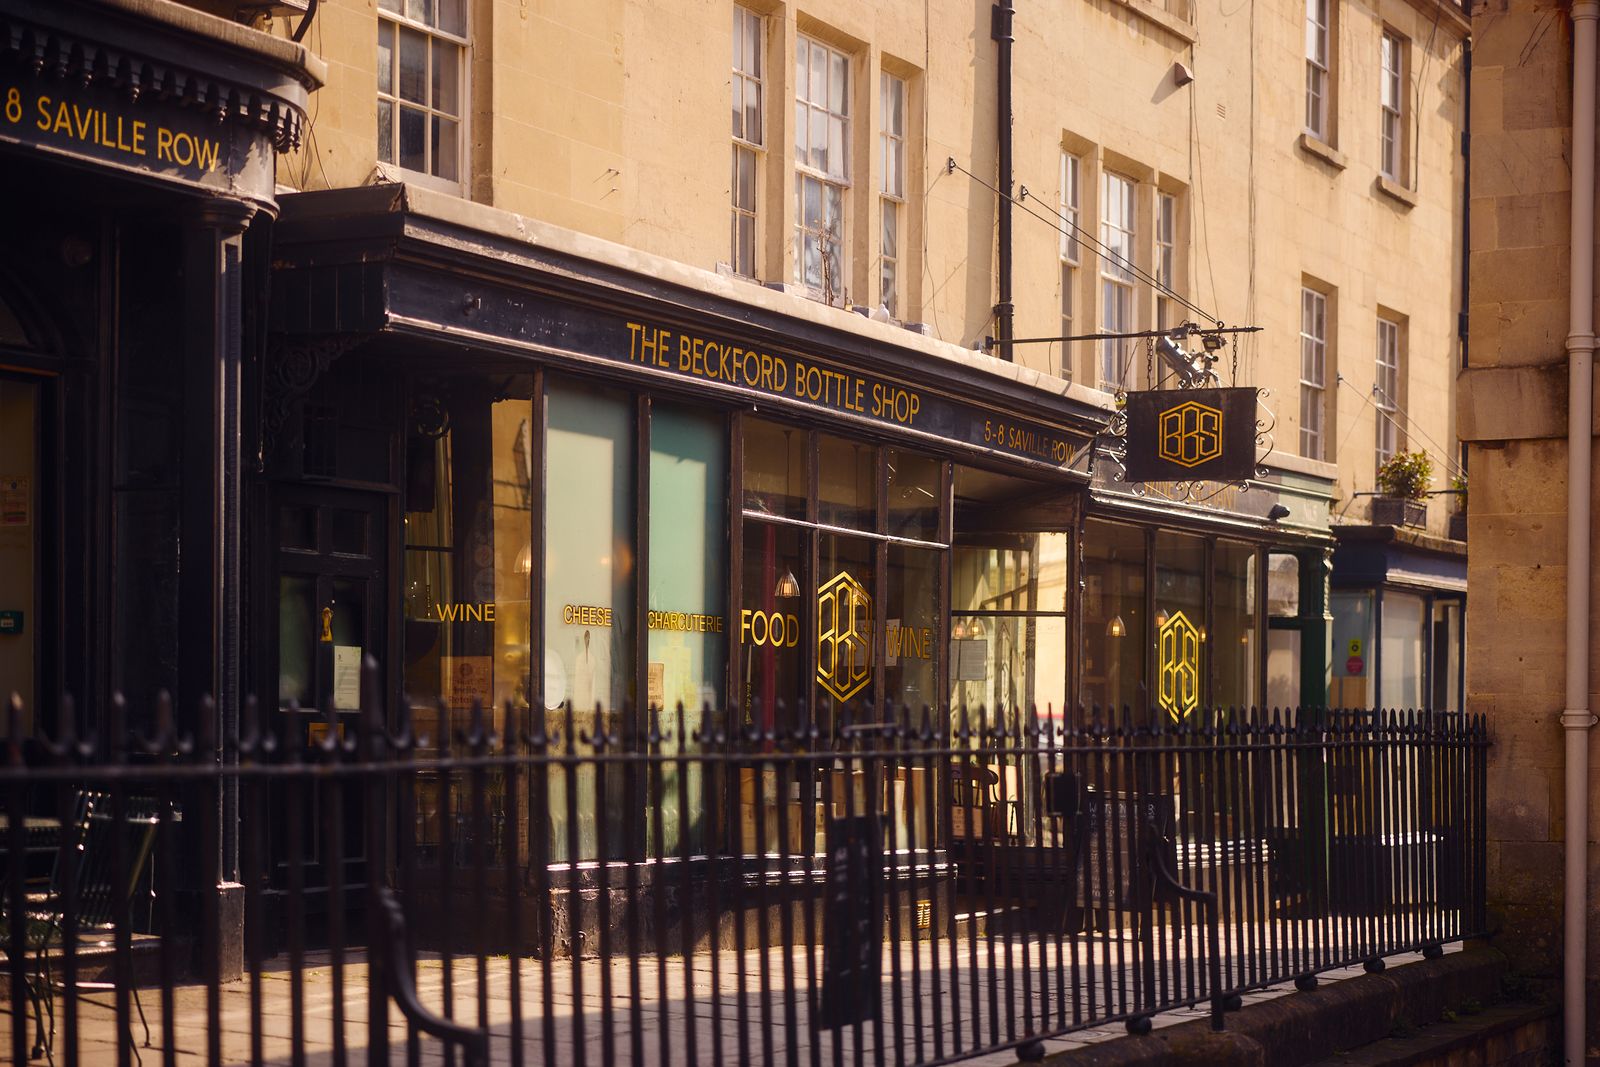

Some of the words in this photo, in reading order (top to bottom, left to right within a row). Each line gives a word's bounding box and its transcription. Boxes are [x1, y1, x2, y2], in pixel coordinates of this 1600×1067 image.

[5, 87, 22, 123] 8
[37, 96, 146, 155] SAVILLE
[157, 127, 220, 172] ROW
[626, 322, 671, 368] THE
[678, 335, 788, 393] BECKFORD
[795, 362, 865, 412] BOTTLE
[872, 383, 920, 424] SHOP
[984, 421, 1005, 445] 5-8
[1008, 426, 1048, 457] SAVILLE
[1051, 440, 1077, 464] ROW
[436, 603, 496, 622] WINE
[563, 605, 613, 627] CHEESE
[647, 610, 723, 633] CHARCUTERIE
[741, 609, 799, 648] FOOD
[886, 624, 932, 660] WINE
